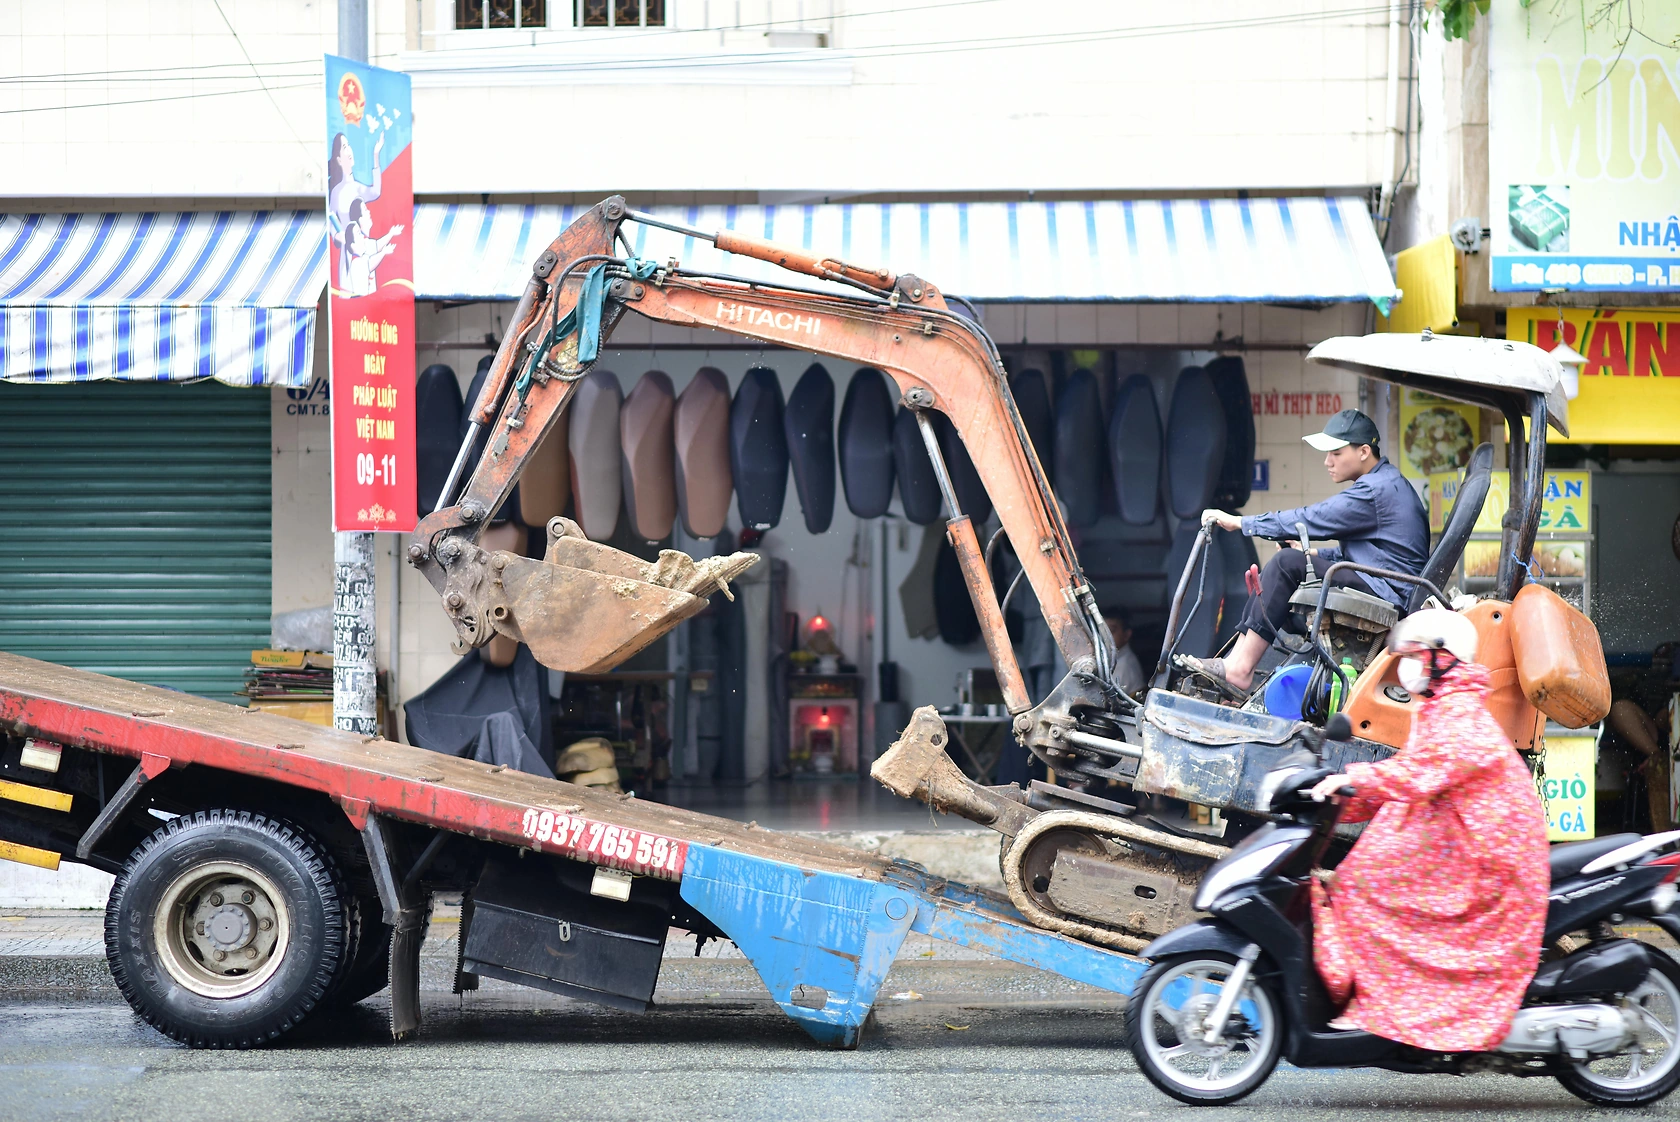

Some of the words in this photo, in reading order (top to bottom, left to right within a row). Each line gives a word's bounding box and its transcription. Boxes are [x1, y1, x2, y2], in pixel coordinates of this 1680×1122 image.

[1533, 53, 1680, 183] MIN
[716, 301, 821, 335] HITACHI
[363, 350, 386, 375] NGÀY
[286, 404, 330, 416] CMT.8
[353, 382, 376, 406] PHÁP
[377, 384, 398, 412] LUẬT
[1283, 393, 1312, 418] THỊT
[1316, 393, 1342, 414] HEO
[356, 414, 375, 443] VIỆT
[376, 419, 395, 440] NAM
[356, 452, 396, 486] 09-11
[1559, 806, 1586, 832] GÀ
[522, 808, 586, 848] 0937
[587, 823, 634, 860] 765
[635, 833, 679, 871] 591
